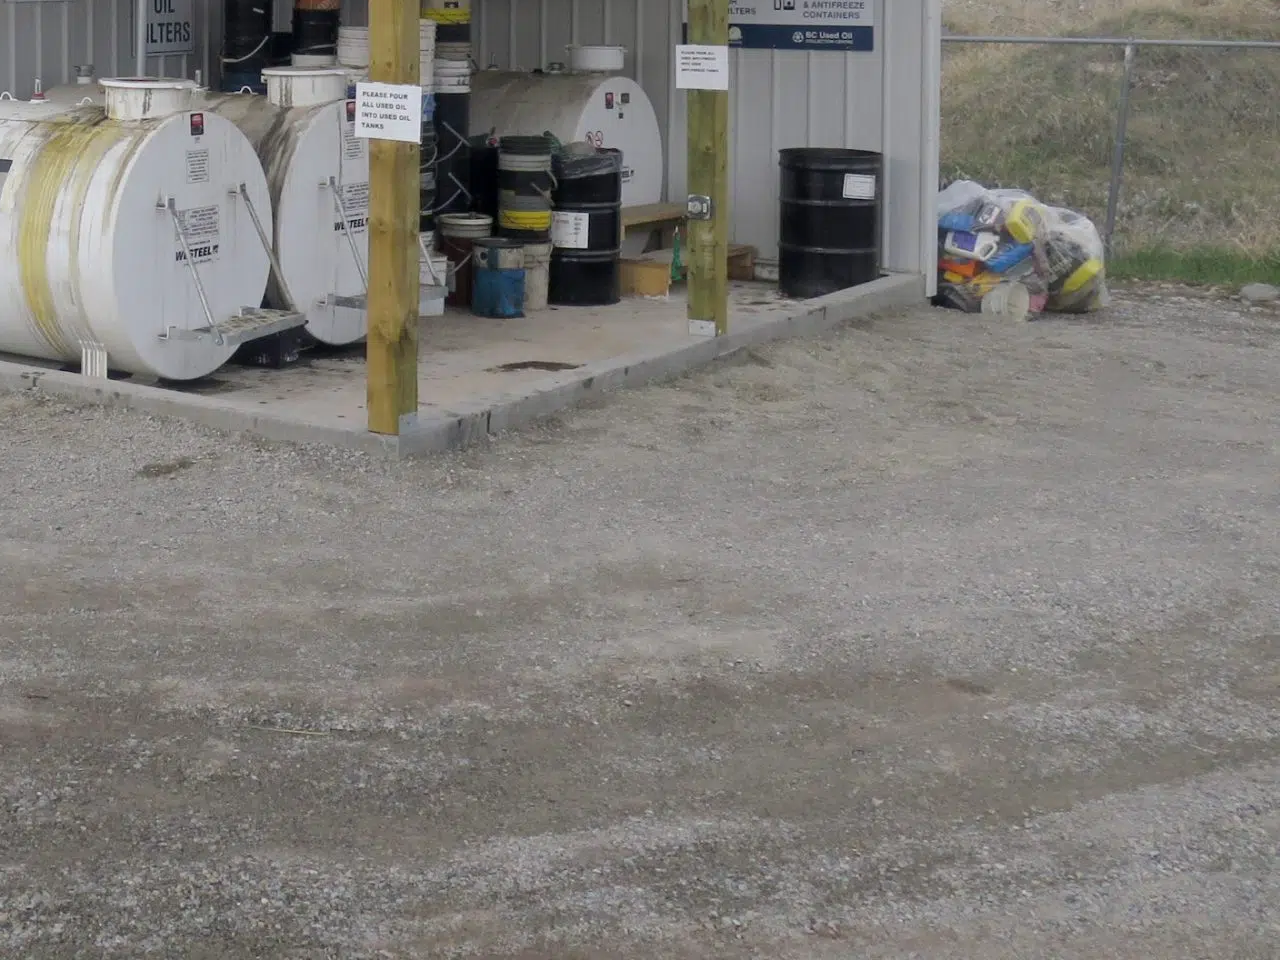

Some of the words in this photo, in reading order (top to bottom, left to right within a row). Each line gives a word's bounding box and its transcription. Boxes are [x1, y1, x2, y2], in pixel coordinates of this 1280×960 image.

[728, 7, 756, 15] ILTERS
[803, 11, 860, 19] CONTAINERS
[146, 21, 190, 43] ILTERS
[362, 91, 388, 99] PLEASE
[361, 122, 384, 130] TANKS
[334, 218, 364, 231] WETEEL
